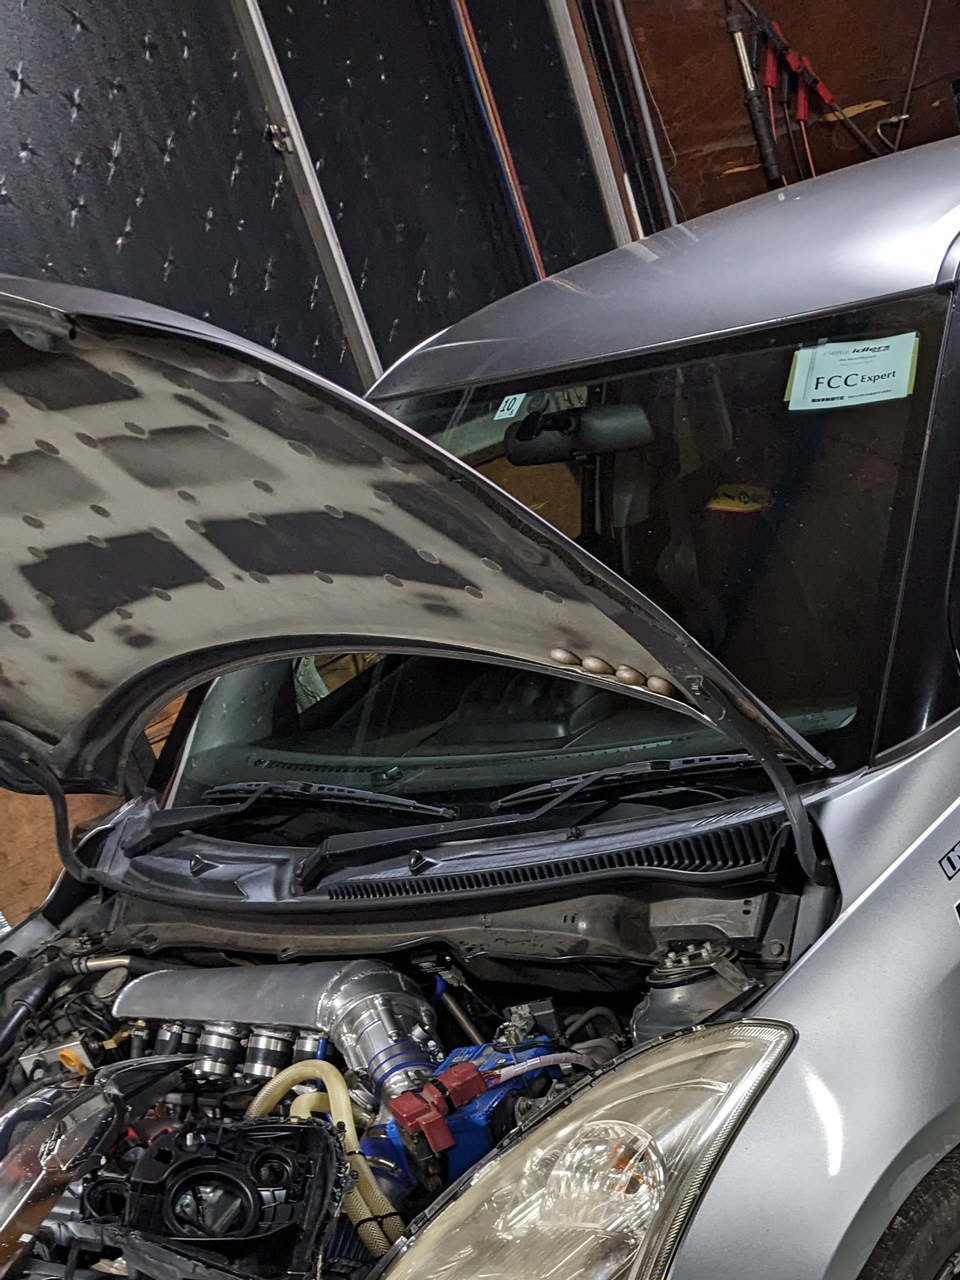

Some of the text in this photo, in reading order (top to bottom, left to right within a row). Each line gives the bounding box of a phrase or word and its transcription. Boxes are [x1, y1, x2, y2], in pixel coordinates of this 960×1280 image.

[851, 344, 891, 354] idlers
[814, 370, 897, 391] FCC Expert
[500, 397, 517, 413] 10
